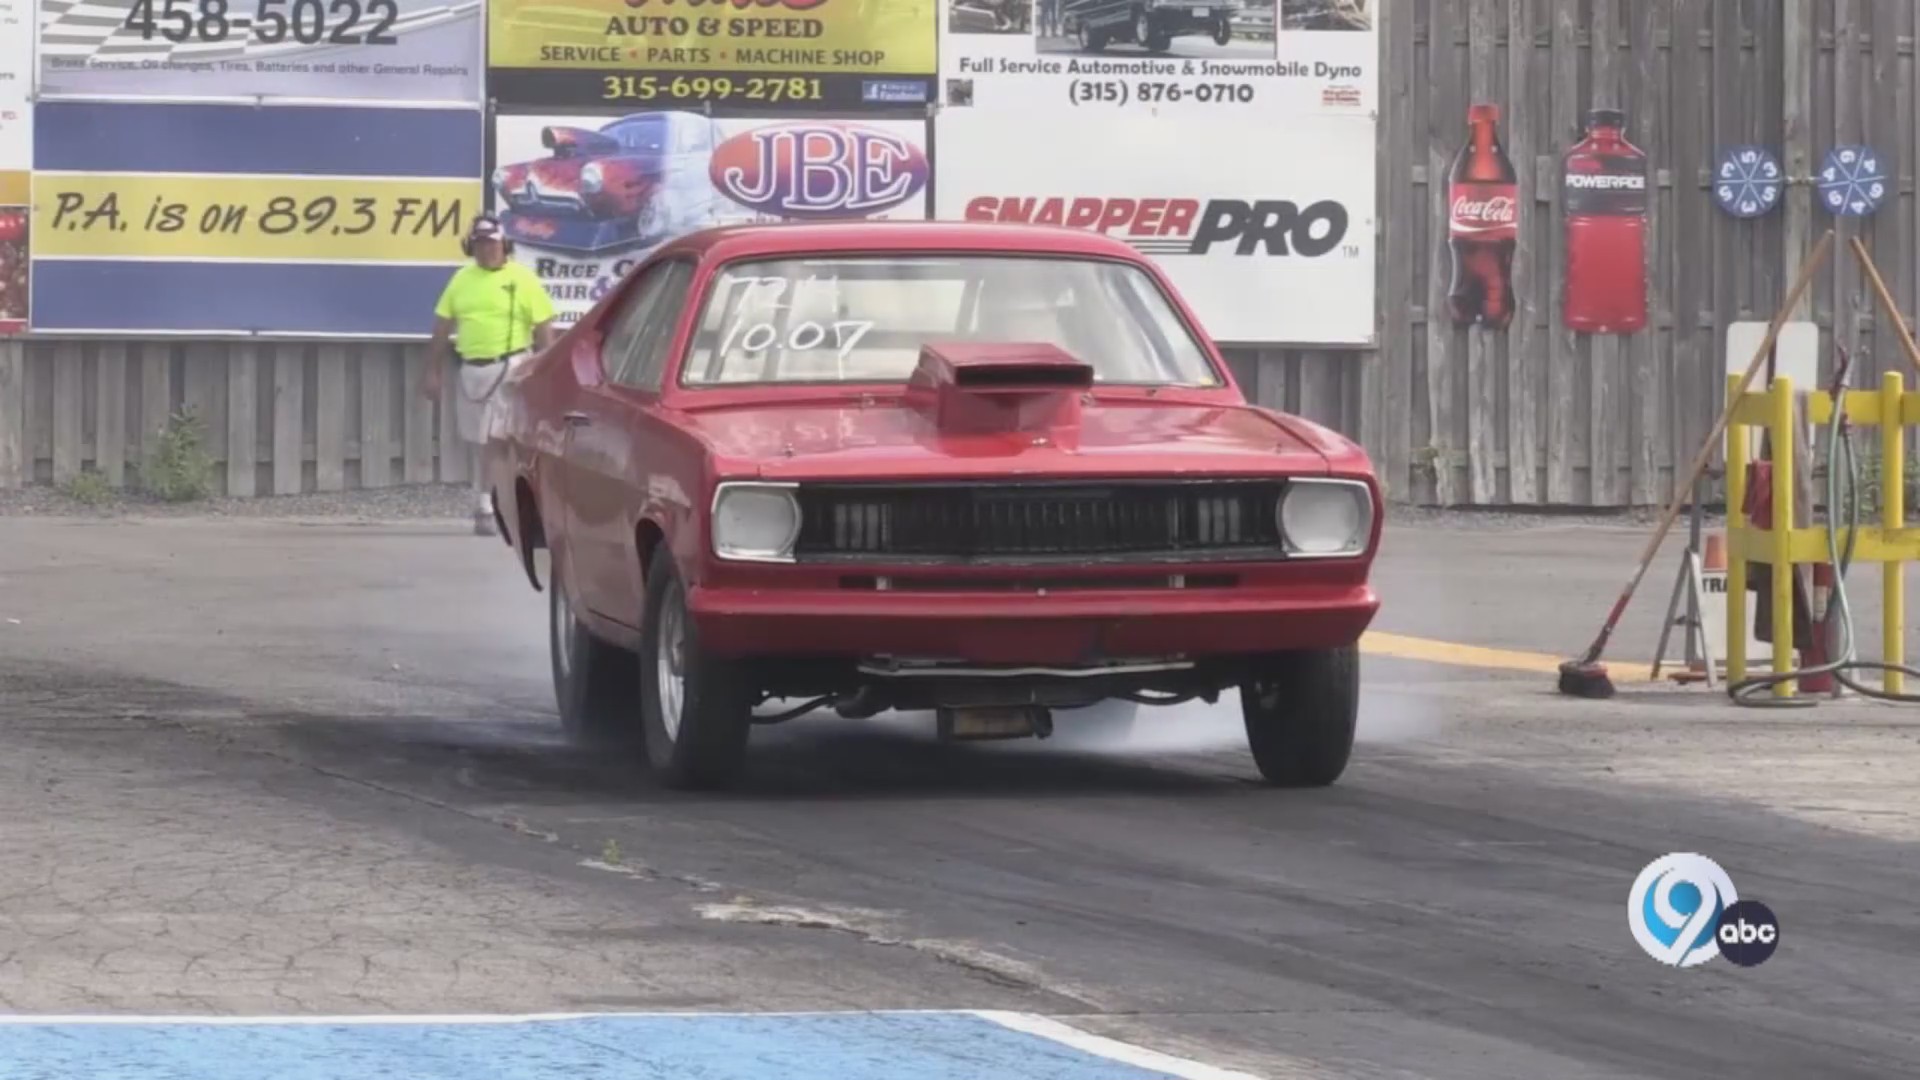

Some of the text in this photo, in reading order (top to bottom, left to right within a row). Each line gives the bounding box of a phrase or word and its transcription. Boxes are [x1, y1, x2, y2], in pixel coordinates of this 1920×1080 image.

[125, 0, 398, 45] 458-5022
[605, 17, 823, 38] AUTO & SPEED
[256, 61, 309, 73] Batteries
[313, 63, 335, 73] and
[339, 63, 370, 74] other
[373, 63, 419, 75] General
[423, 64, 469, 76] Repairs
[540, 45, 885, 66] SERVICE PARTS MACHINE SHOP
[959, 58, 1361, 79] Full Service Automotive & Snowmobile Dyno
[603, 75, 822, 101] 315-699-2781
[1069, 80, 1254, 106] (315) 876-0710
[725, 127, 911, 212] JBE
[52, 191, 463, 237] P.A. is on 89.3 FM
[964, 196, 1199, 236] SNAPPER
